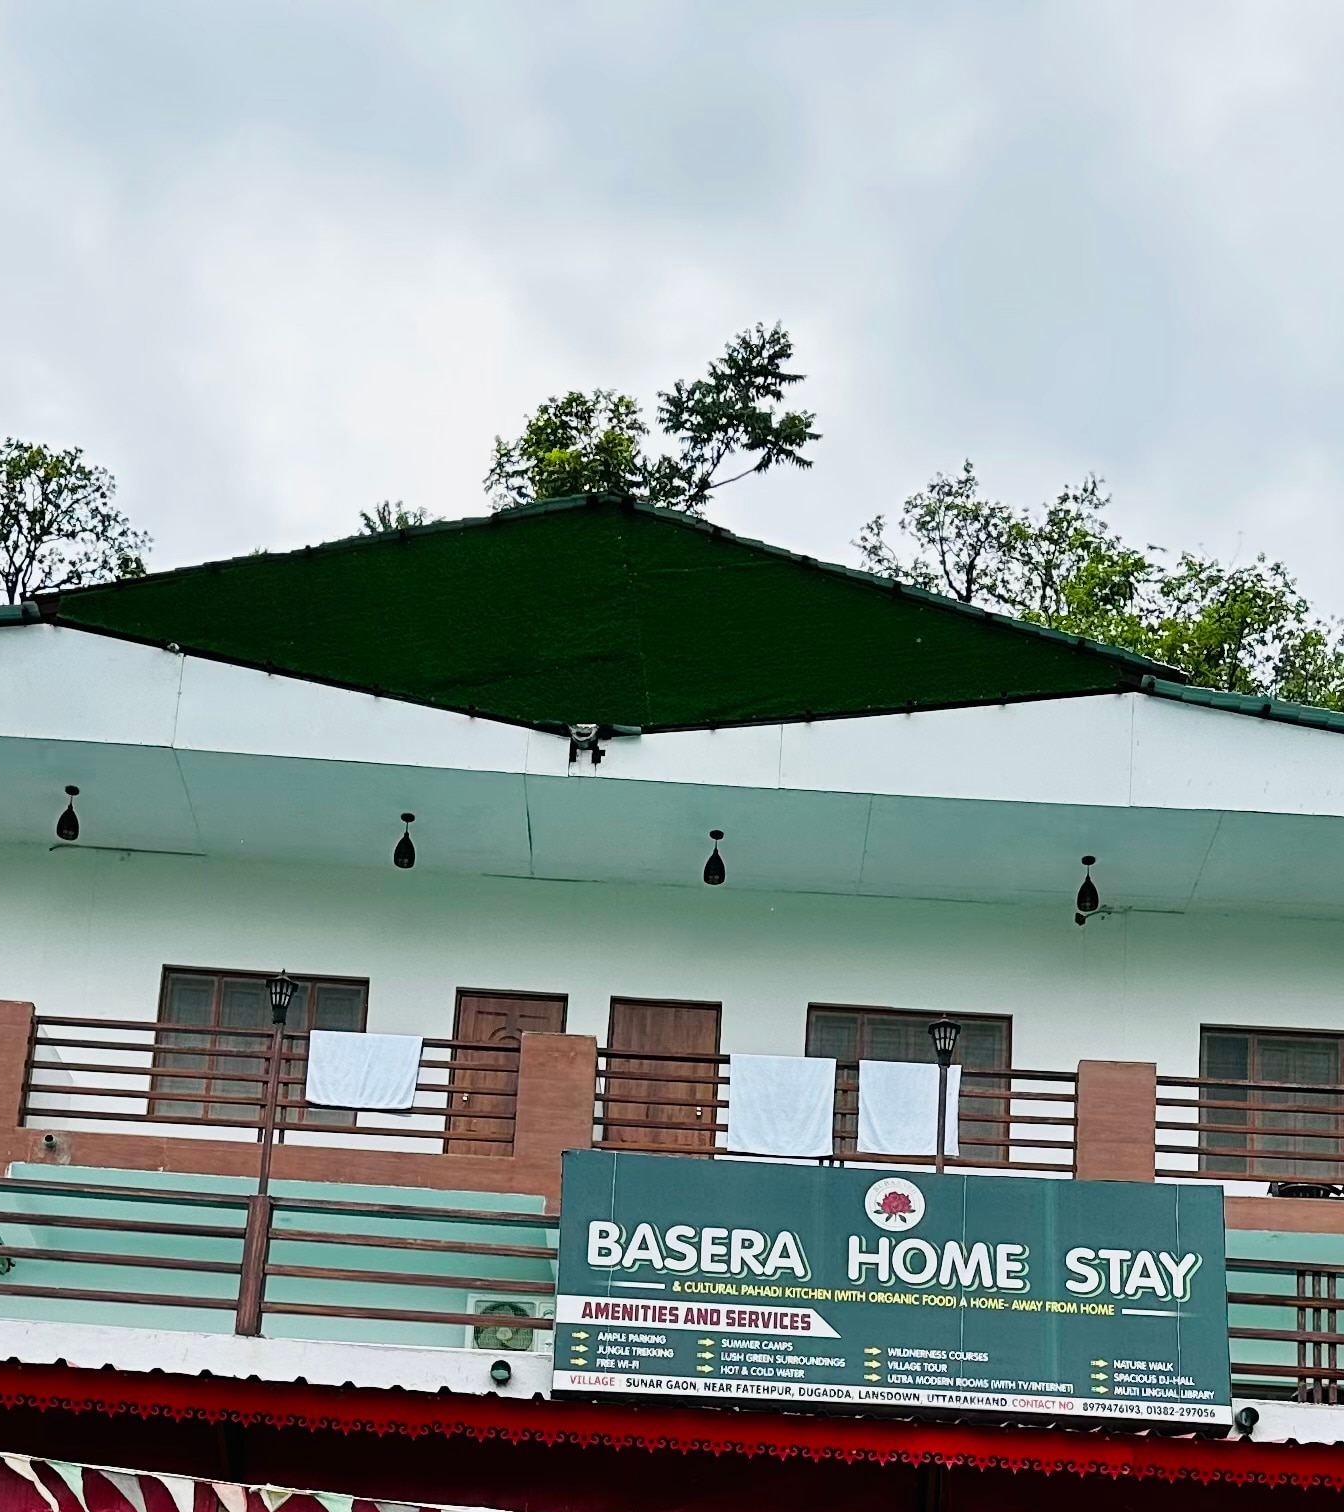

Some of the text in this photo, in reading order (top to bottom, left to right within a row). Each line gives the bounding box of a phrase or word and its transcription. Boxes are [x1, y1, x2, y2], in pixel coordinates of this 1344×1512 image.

[587, 1220, 1200, 1300] BASERA HOME STAY
[672, 1282, 1115, 1316] & CULTURAL PAHADI KITCHEN (WITH ORGANIC FOOD) A HOME- AWAY FROM HOME
[581, 1302, 811, 1331] AMENITIES AND SERVICES
[598, 1332, 667, 1344] AMPLE PARKING
[596, 1345, 674, 1358] JUNGLE TREKKING
[721, 1339, 793, 1351] SUMMER CAMPS
[720, 1352, 846, 1368] LUSH GREEN SURROUNDINGS
[948, 1351, 989, 1362] COURSES
[596, 1358, 640, 1369] FREE WI-FI
[887, 1361, 948, 1373] VILLAGE TOUR
[1113, 1360, 1174, 1372] NATURE WALK
[720, 1365, 805, 1378] HOT & COLD WATER
[887, 1374, 913, 1384] ULTRA
[916, 1376, 954, 1387] MODERN
[956, 1378, 989, 1389] ROOMS
[990, 1380, 1016, 1390] (WITH
[1113, 1373, 1195, 1386] SPACIOUS DJ-HALL
[570, 1375, 615, 1386] VILLAGE
[626, 1378, 662, 1389] SUNAR
[666, 1380, 700, 1392] GAON,
[704, 1382, 732, 1393] NEAR
[736, 1384, 795, 1397] FATEHPUR,
[798, 1387, 854, 1400] DUGADDA,
[858, 1390, 922, 1404] LANSDOWN,
[1012, 1399, 1056, 1409] CONTACT
[1058, 1401, 1074, 1411] NO
[1146, 1405, 1216, 1418] 01382-297056
[1114, 1386, 1215, 1400] MULTI LINGUAL LIBRARY
